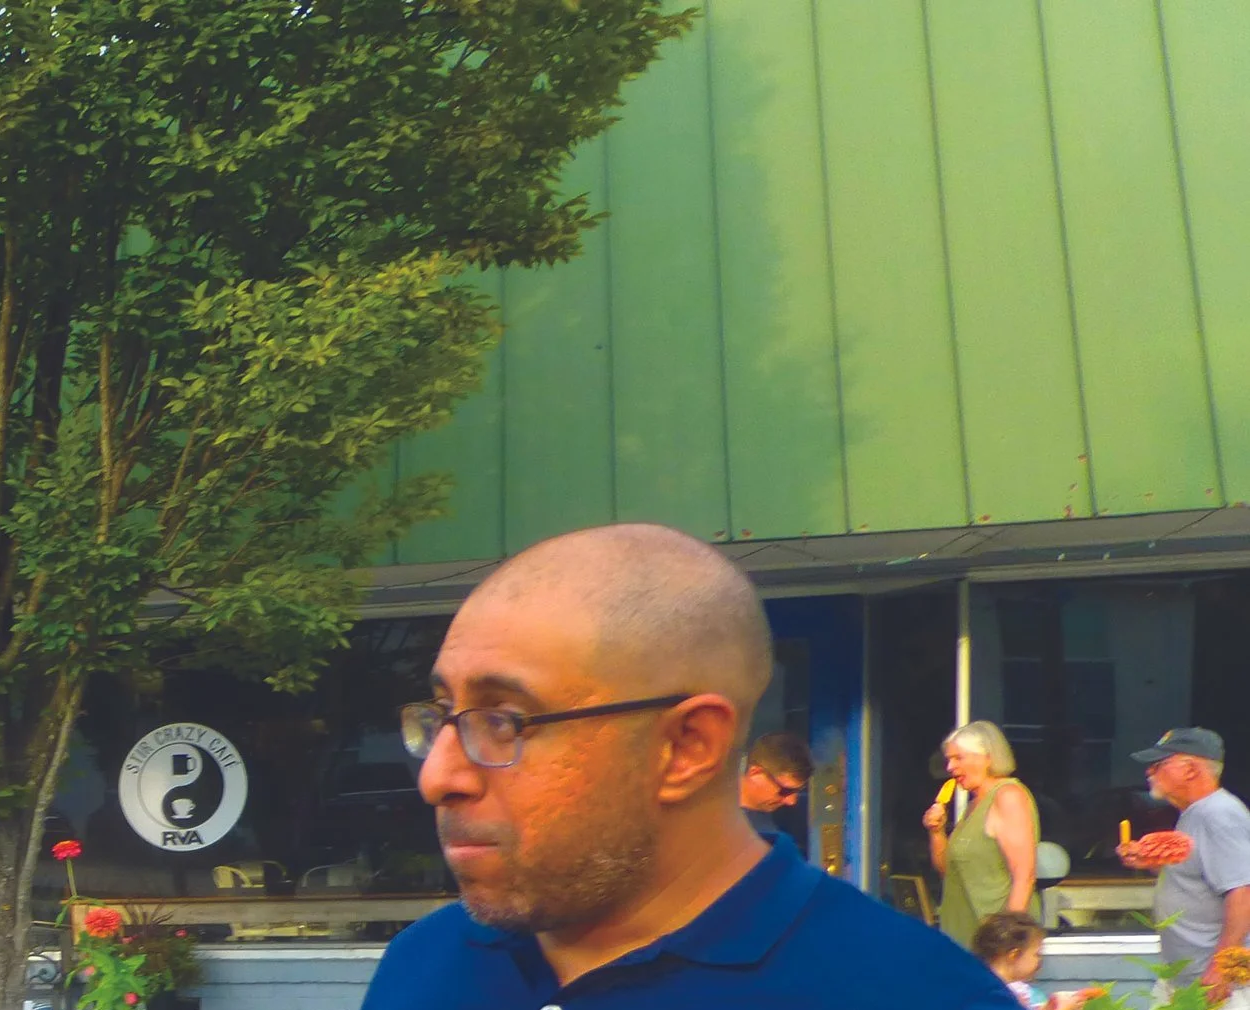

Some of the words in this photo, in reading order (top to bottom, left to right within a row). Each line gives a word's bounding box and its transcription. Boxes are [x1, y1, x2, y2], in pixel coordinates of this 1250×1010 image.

[126, 741, 152, 775] STIR
[154, 726, 207, 747] CRAZY
[161, 829, 204, 847] RVA
